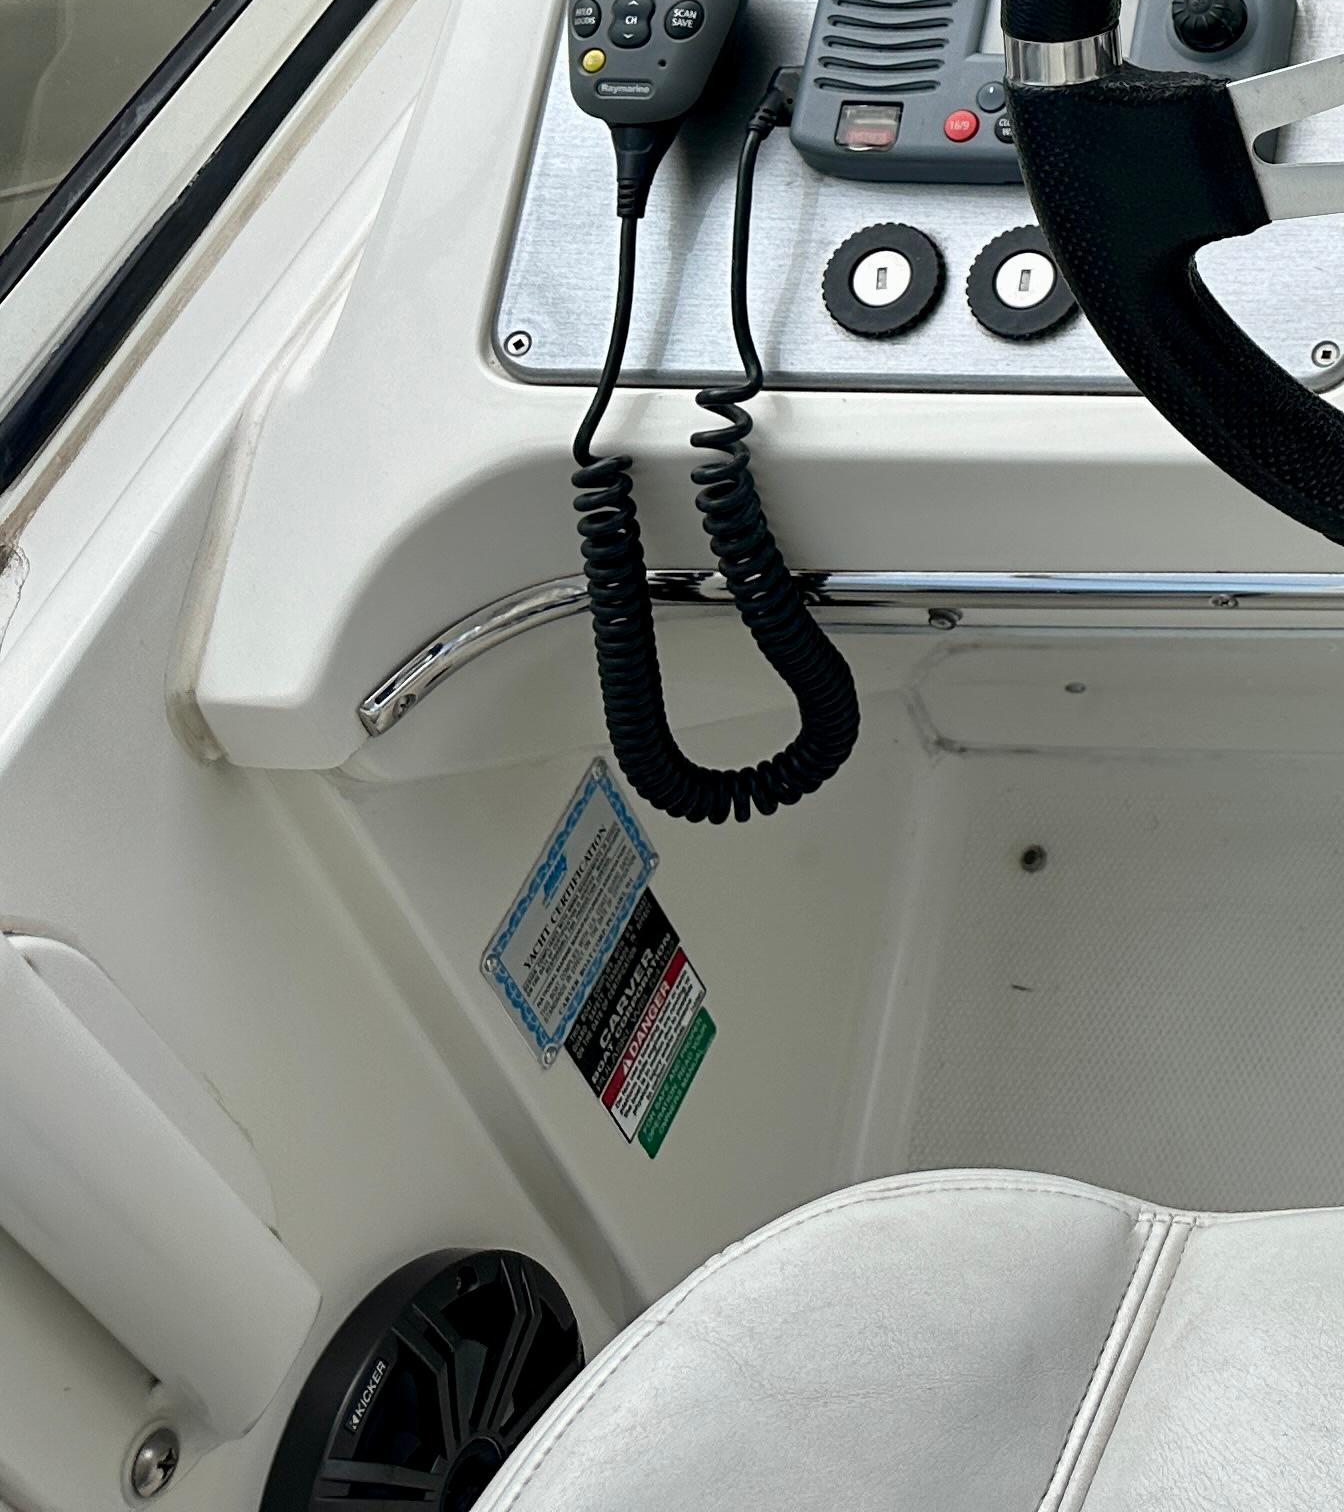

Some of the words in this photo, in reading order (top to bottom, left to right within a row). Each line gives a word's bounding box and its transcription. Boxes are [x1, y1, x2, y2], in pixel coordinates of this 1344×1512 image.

[624, 15, 639, 25] CH
[671, 18, 694, 29] SAVE
[672, 7, 698, 19] SCAN
[600, 82, 651, 94] Raymarine
[523, 924, 551, 972] YACHT
[549, 823, 607, 926] CERTIFICATION
[590, 1039, 615, 1085] BOAT
[613, 929, 672, 1040] CORPORATION
[597, 944, 654, 1051] CARVER
[627, 977, 670, 1059] DANGER
[354, 1360, 387, 1418] KICKER
